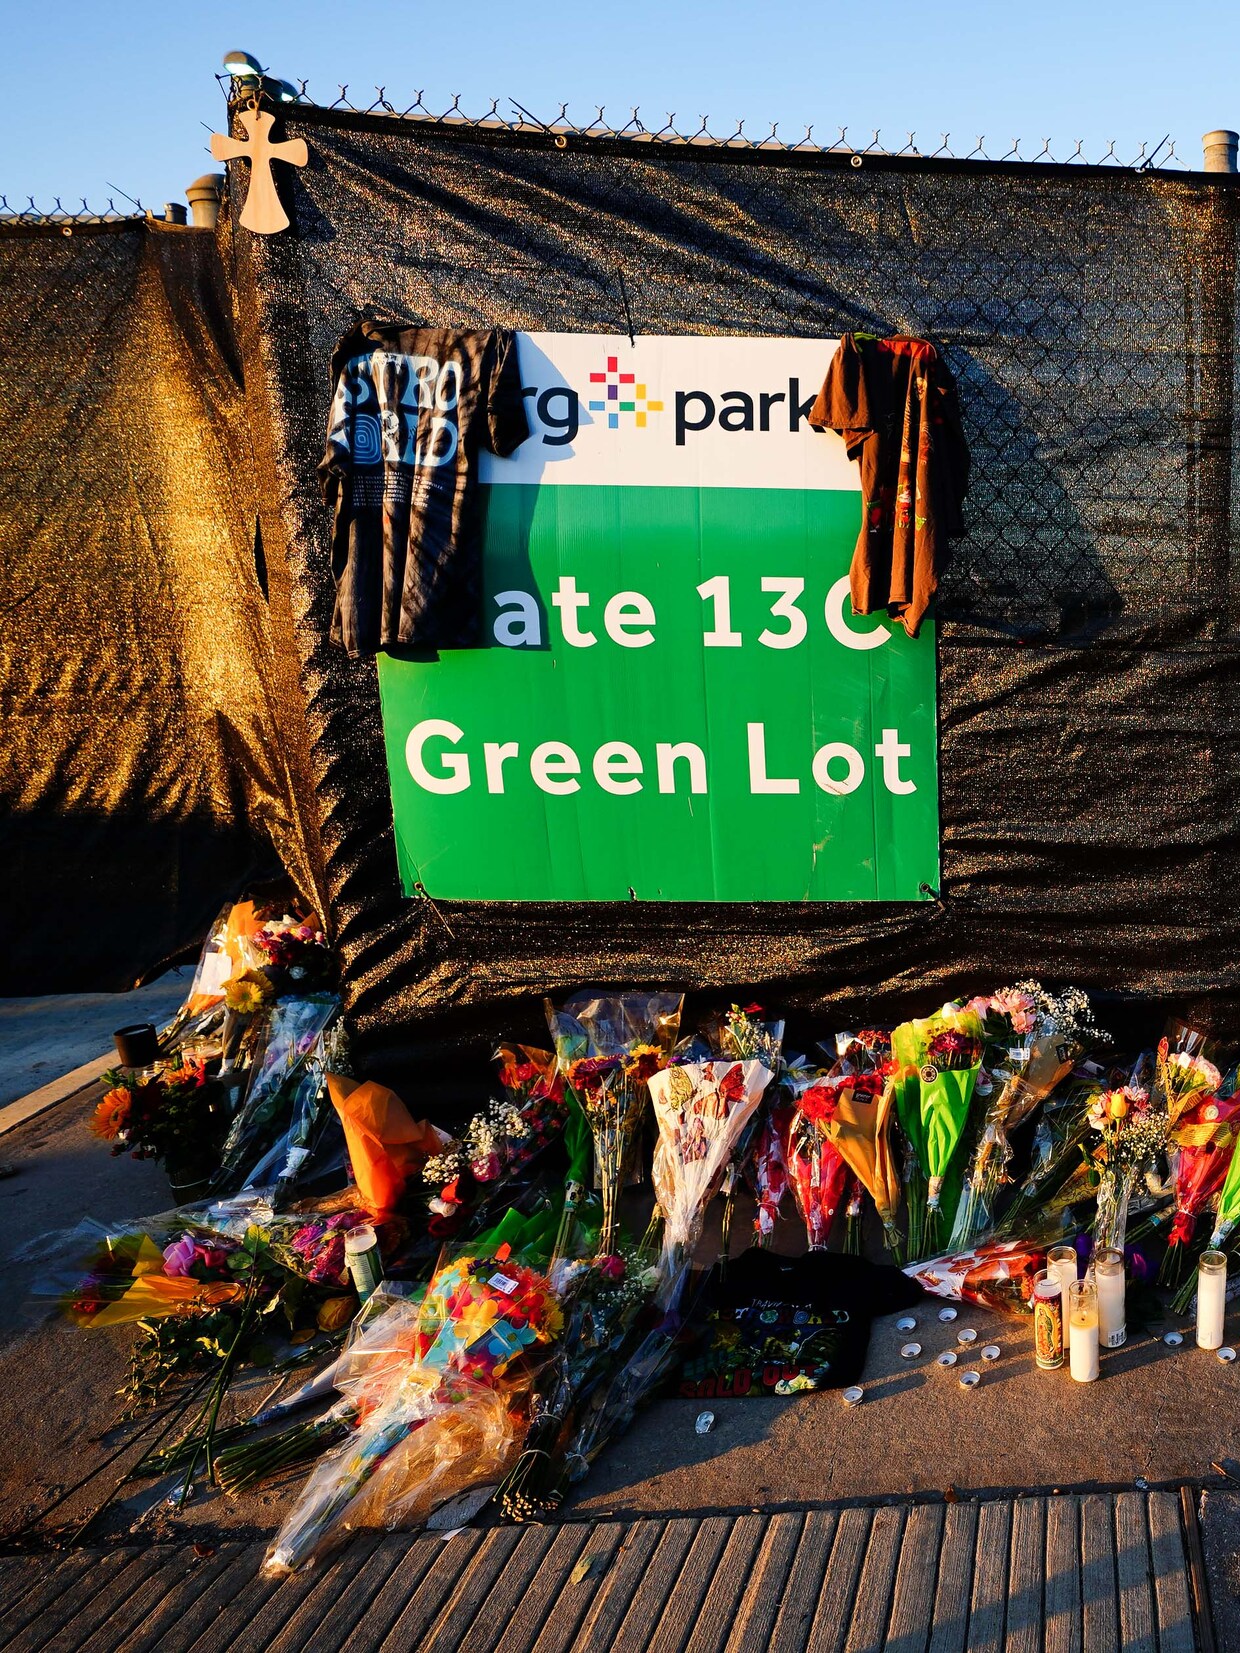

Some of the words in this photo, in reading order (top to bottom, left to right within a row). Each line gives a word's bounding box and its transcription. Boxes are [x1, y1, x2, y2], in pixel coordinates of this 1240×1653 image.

[520, 386, 579, 446] rg
[675, 377, 827, 446] park
[493, 575, 656, 650] ate
[696, 574, 892, 652] 13C
[404, 718, 709, 796] Green
[747, 721, 918, 796] Lot
